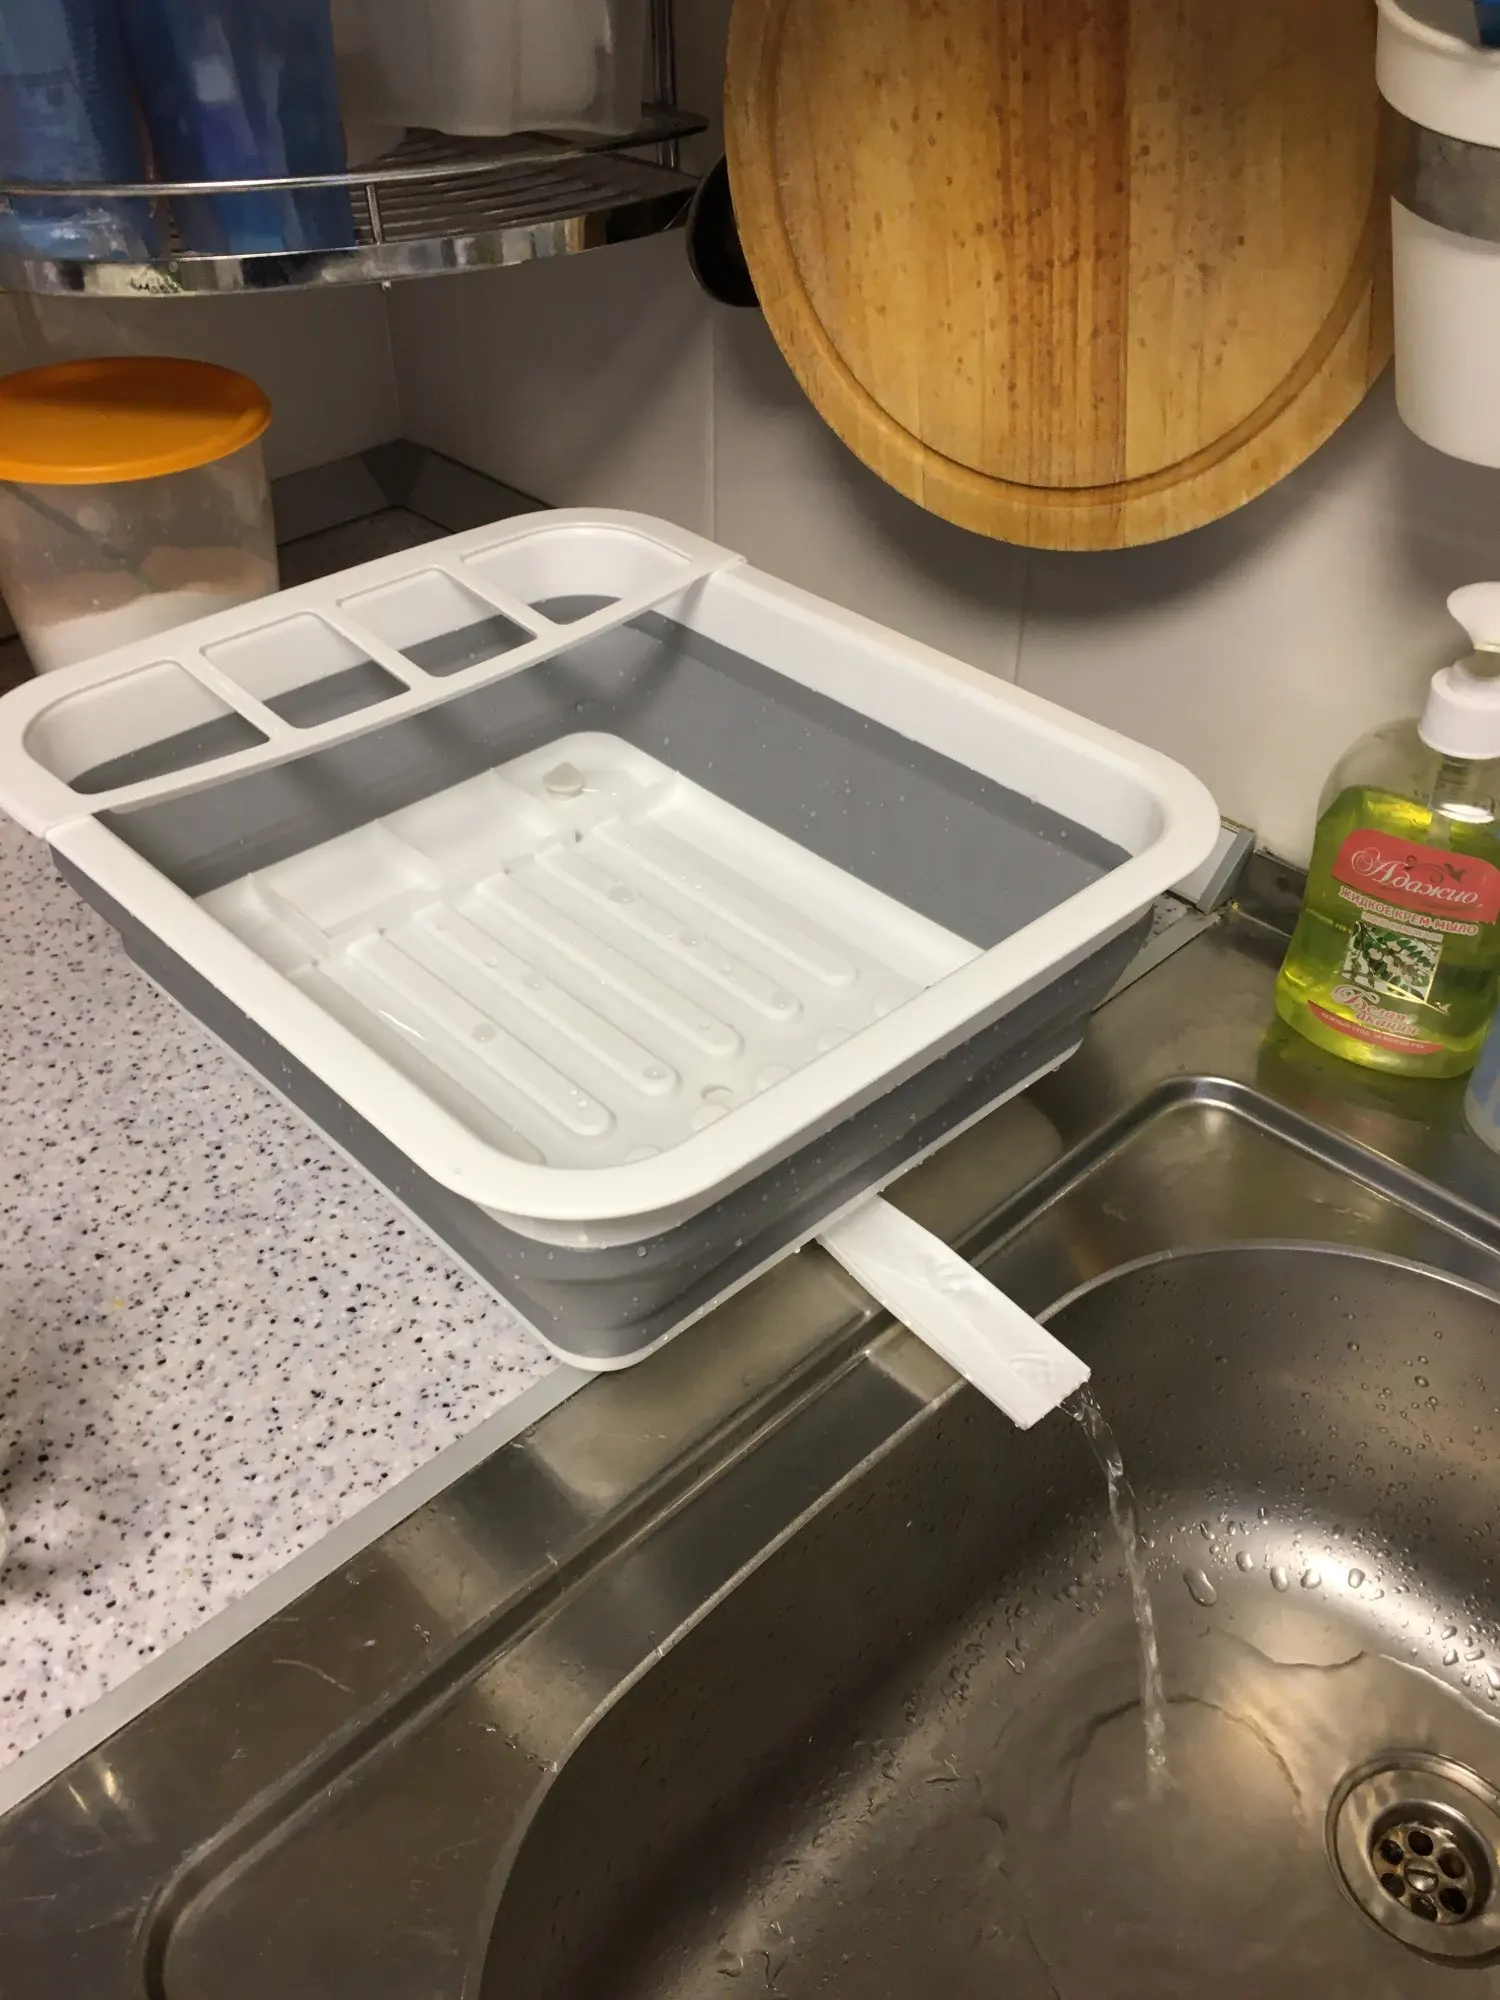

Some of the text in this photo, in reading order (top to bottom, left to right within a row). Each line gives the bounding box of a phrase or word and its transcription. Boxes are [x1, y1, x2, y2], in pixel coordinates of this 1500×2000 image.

[1351, 847, 1478, 904] Адажио
[1339, 886, 1393, 916] ЖИДКОЕ
[1393, 910, 1478, 936] КРЕМ-МЫЛО
